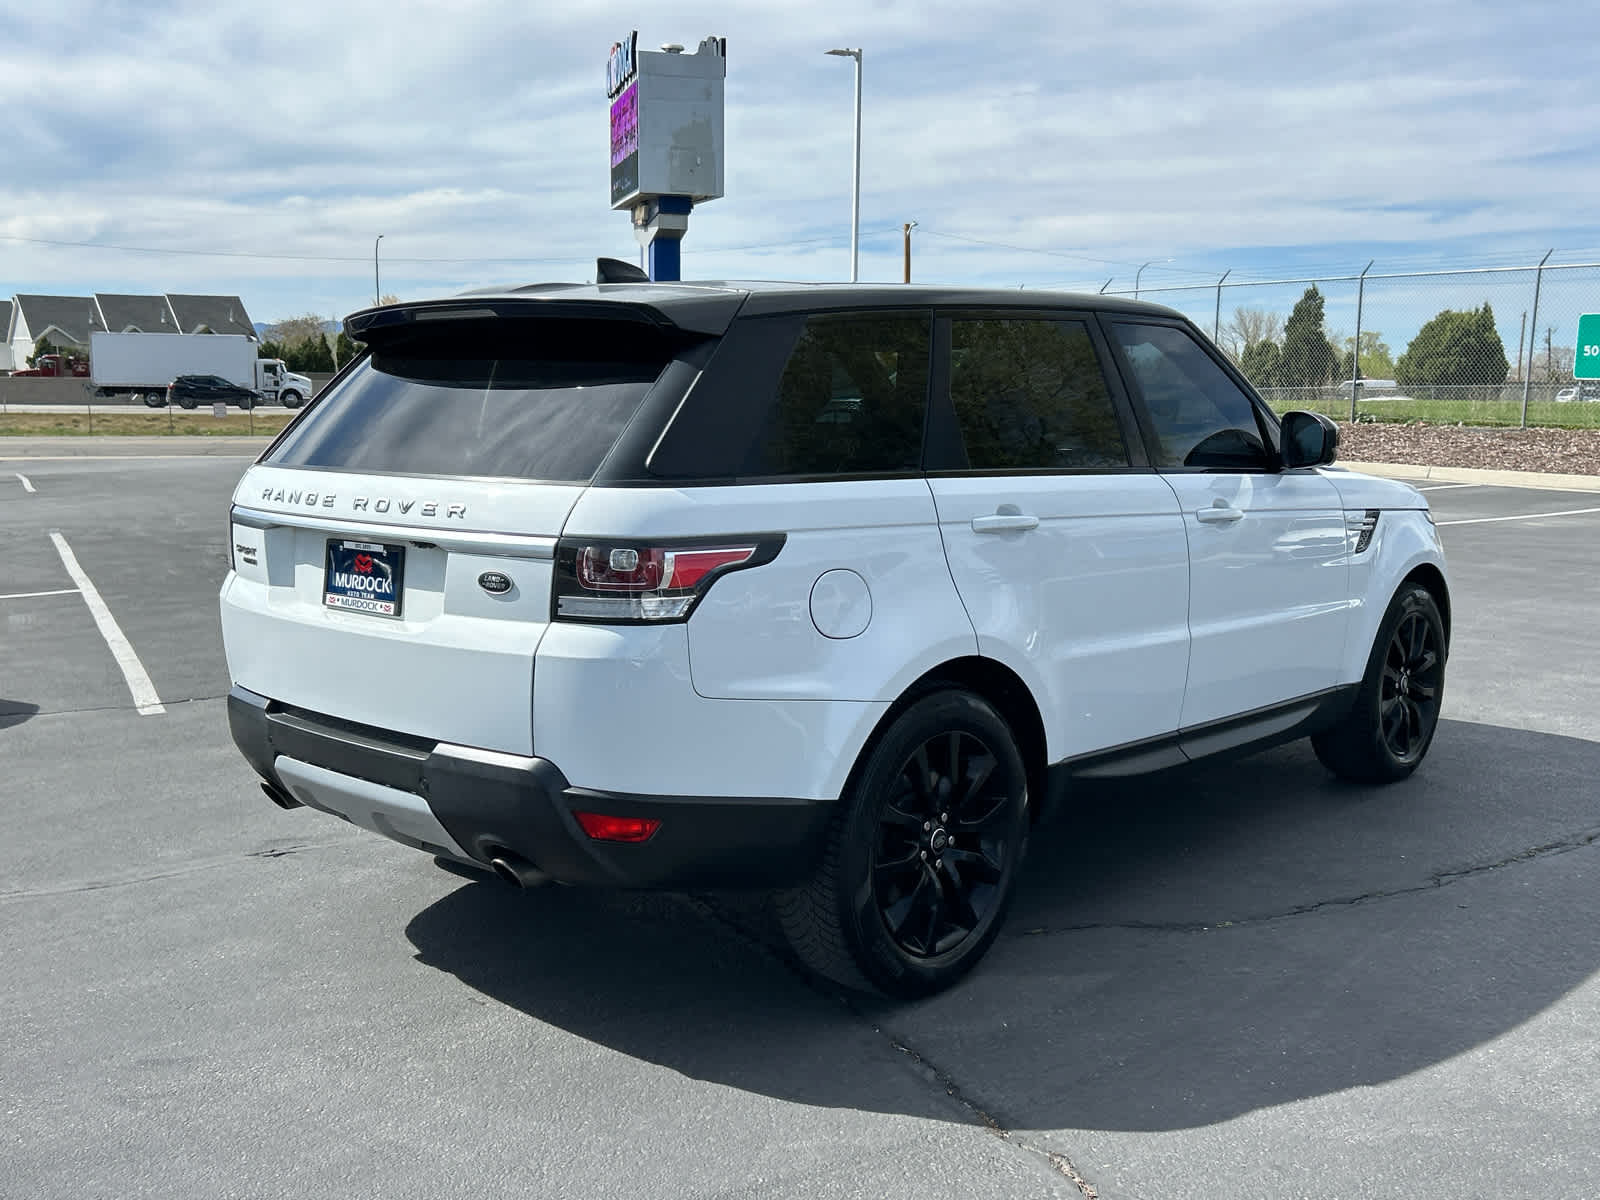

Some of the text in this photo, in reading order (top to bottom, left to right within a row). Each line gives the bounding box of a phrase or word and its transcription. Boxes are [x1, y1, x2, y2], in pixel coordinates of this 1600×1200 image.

[262, 487, 467, 519] RANGE ROVER
[335, 572, 391, 594] MURDOCK
[340, 597, 378, 610] MURDOCK
